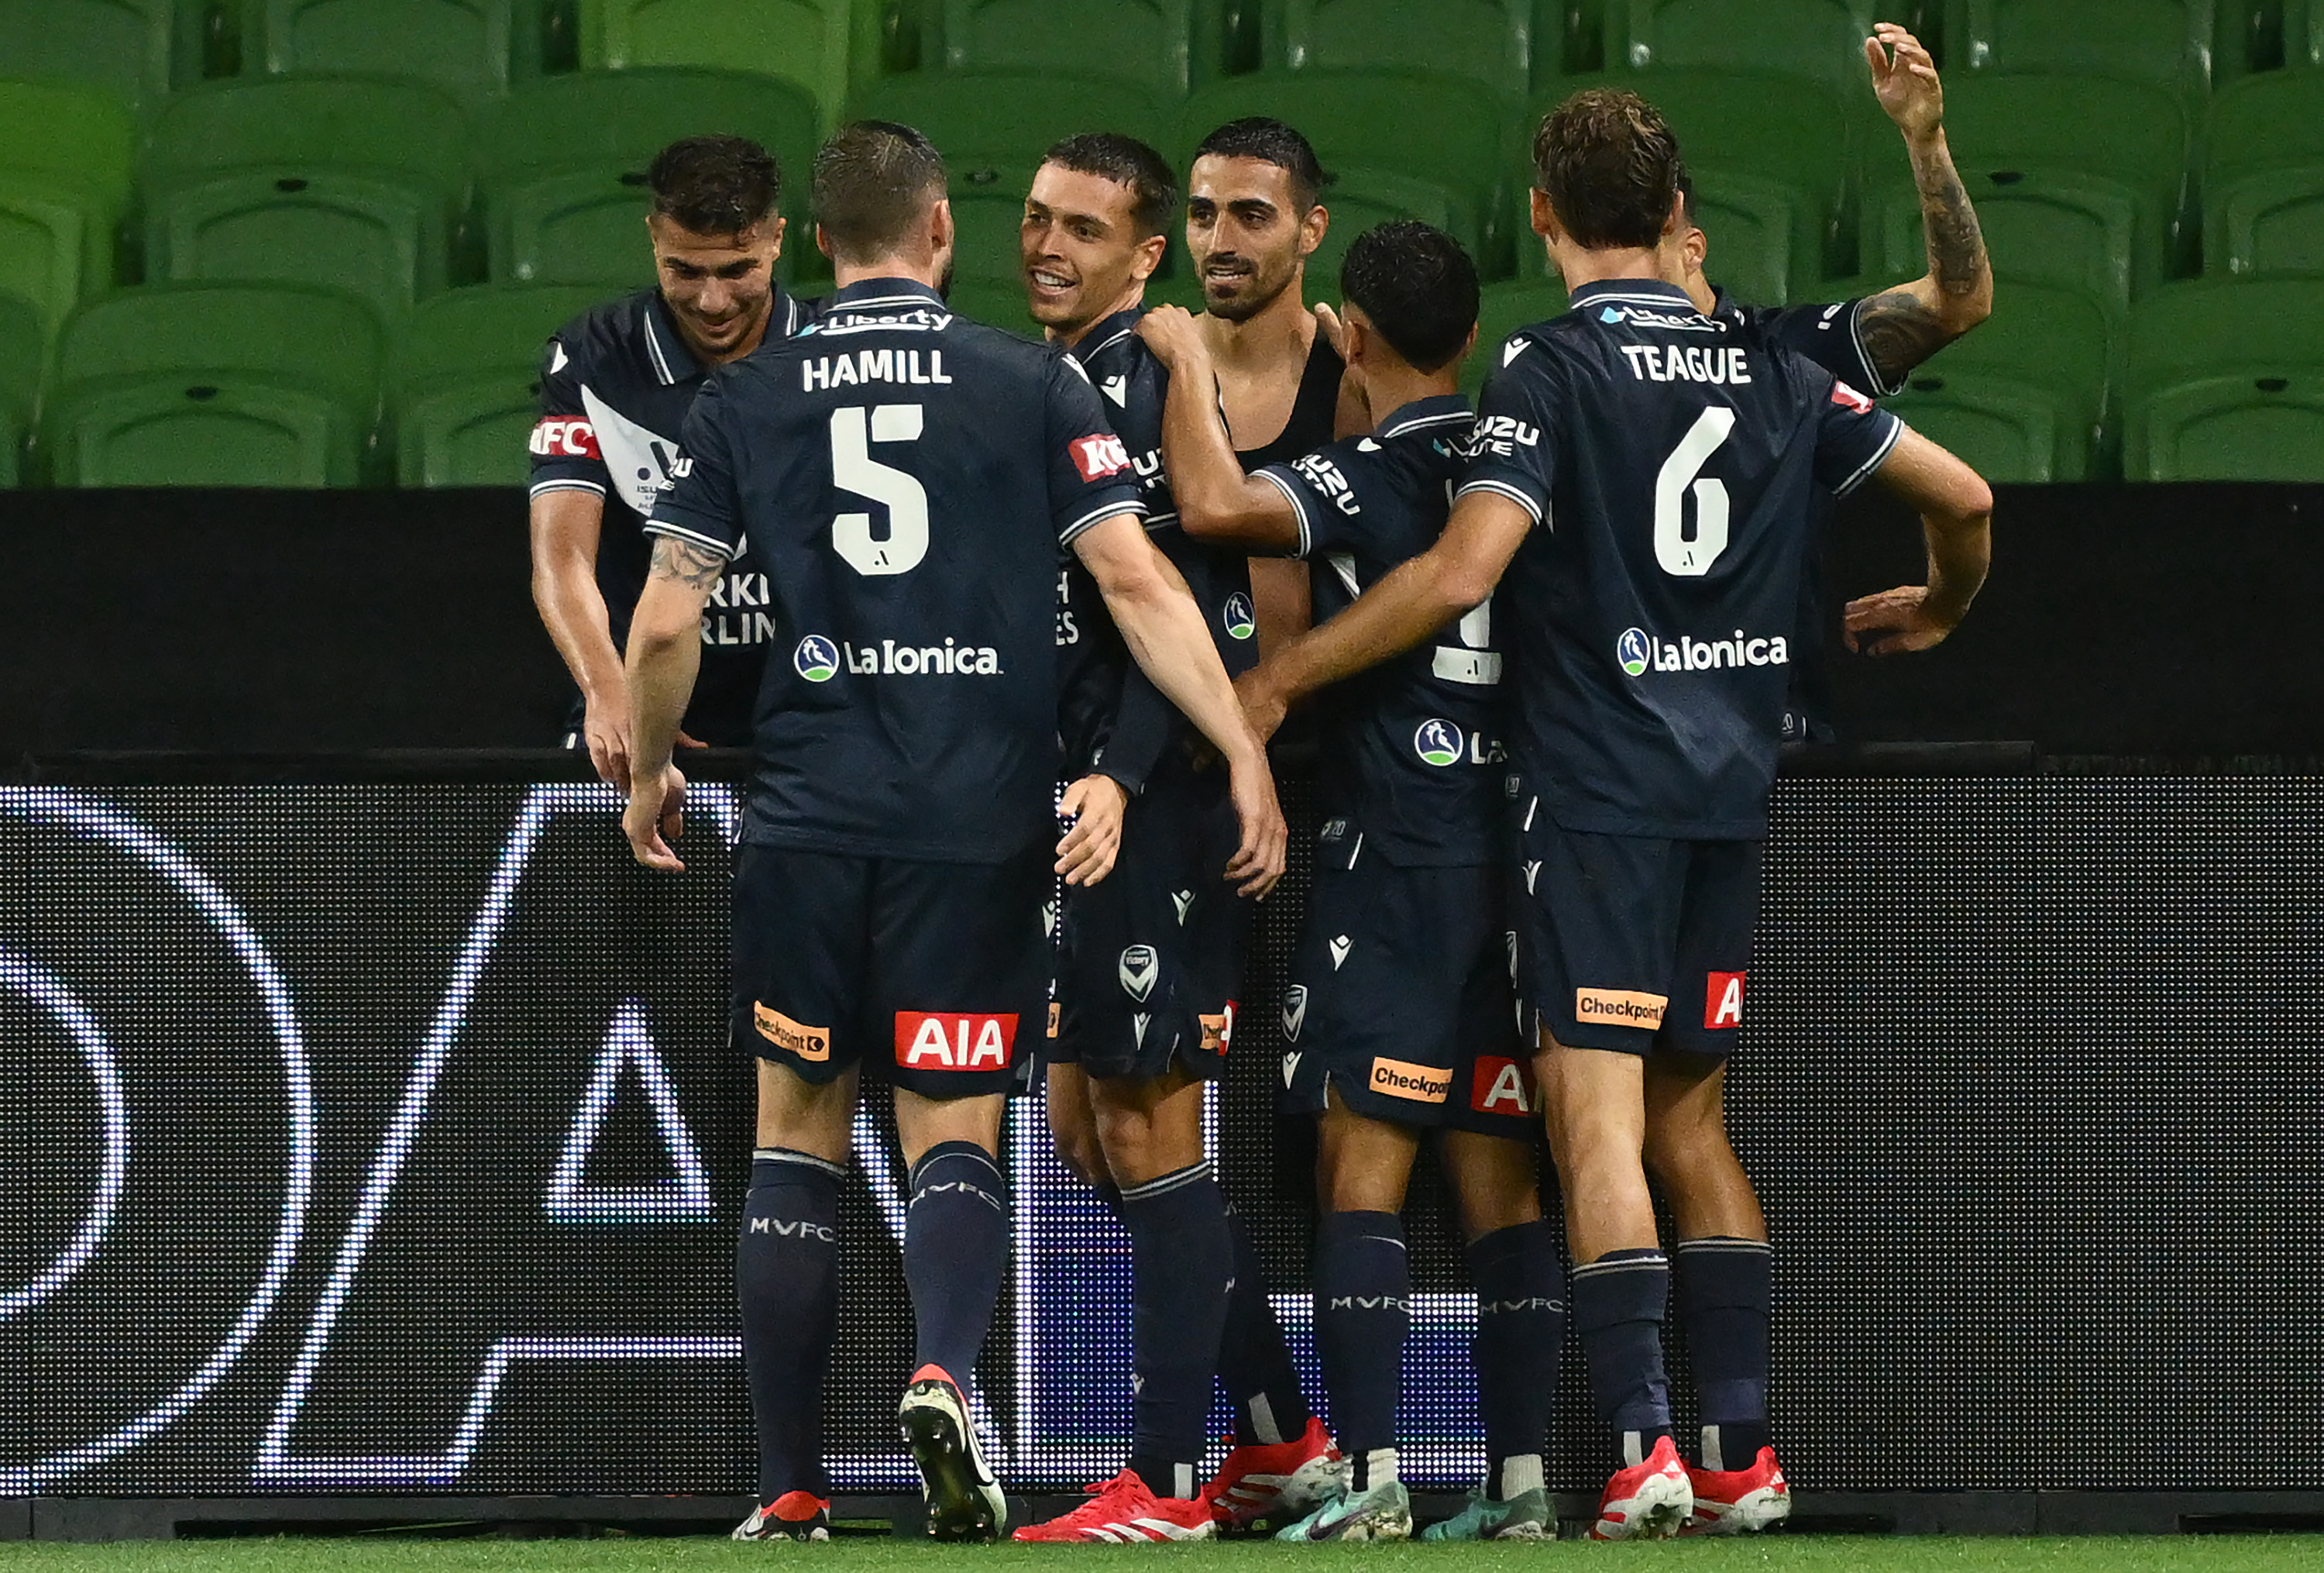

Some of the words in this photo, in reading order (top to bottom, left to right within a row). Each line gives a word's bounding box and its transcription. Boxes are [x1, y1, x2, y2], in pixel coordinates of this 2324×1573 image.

[828, 308, 954, 332] Liberty
[803, 349, 953, 393] HAMILL
[1620, 344, 1752, 385] TEAGUE
[830, 403, 930, 576] 5
[1654, 405, 1737, 577] 6
[906, 1017, 1005, 1066] AIA
[748, 1217, 836, 1242] MVFC
[1329, 1296, 1412, 1314] MVFC
